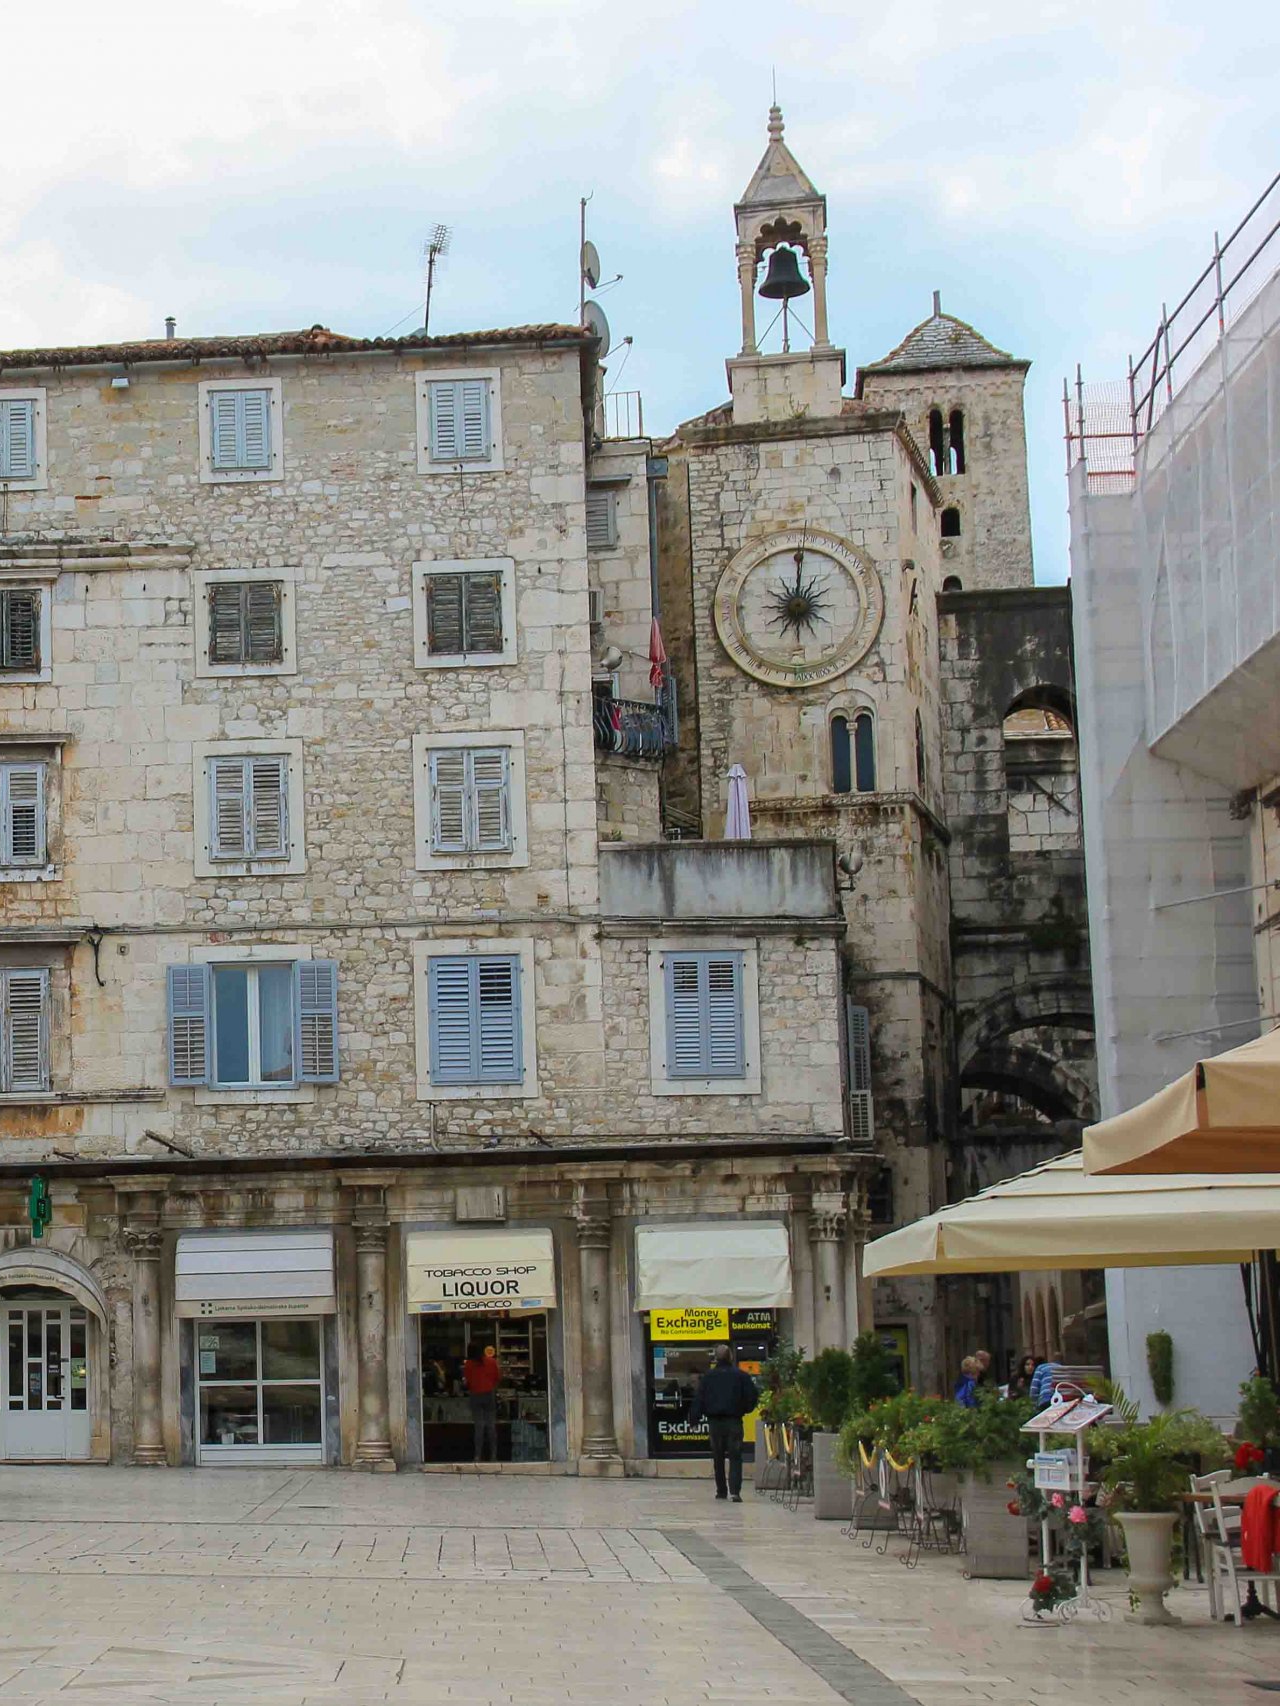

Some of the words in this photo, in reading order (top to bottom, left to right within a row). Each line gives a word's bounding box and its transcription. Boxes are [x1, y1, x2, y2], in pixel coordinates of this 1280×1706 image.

[424, 1268, 492, 1279] TOBACCO
[496, 1265, 537, 1276] SHOP
[442, 1280, 520, 1297] LIQUOR
[451, 1300, 512, 1310] TOBACCO
[684, 1308, 719, 1319] Money
[746, 1312, 771, 1321] ATM
[656, 1317, 723, 1331] Exchange
[731, 1321, 772, 1330] bankomat
[658, 1420, 710, 1433] Exchan
